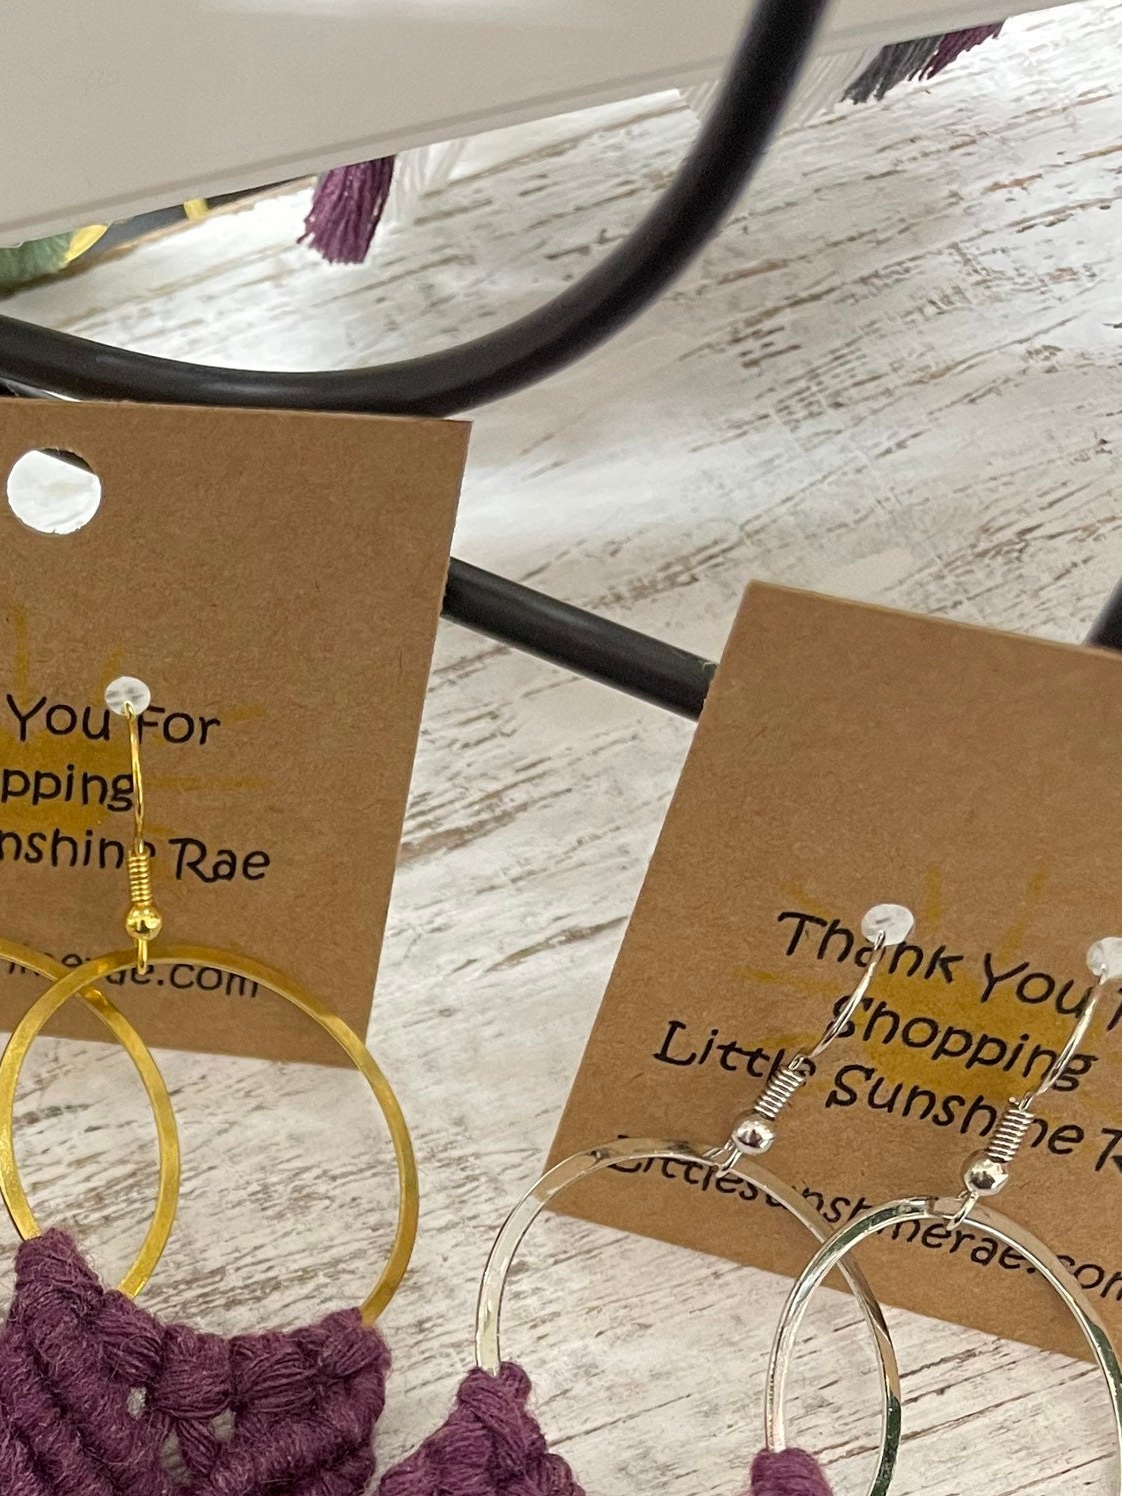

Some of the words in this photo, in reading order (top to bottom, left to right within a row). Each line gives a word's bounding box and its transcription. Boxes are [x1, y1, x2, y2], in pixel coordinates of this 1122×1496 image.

[6, 693, 110, 742] You
[168, 837, 271, 883] Rae
[981, 952, 1094, 1019] You
[826, 994, 1099, 1091] Shopping
[825, 1064, 1085, 1155] Sunshne
